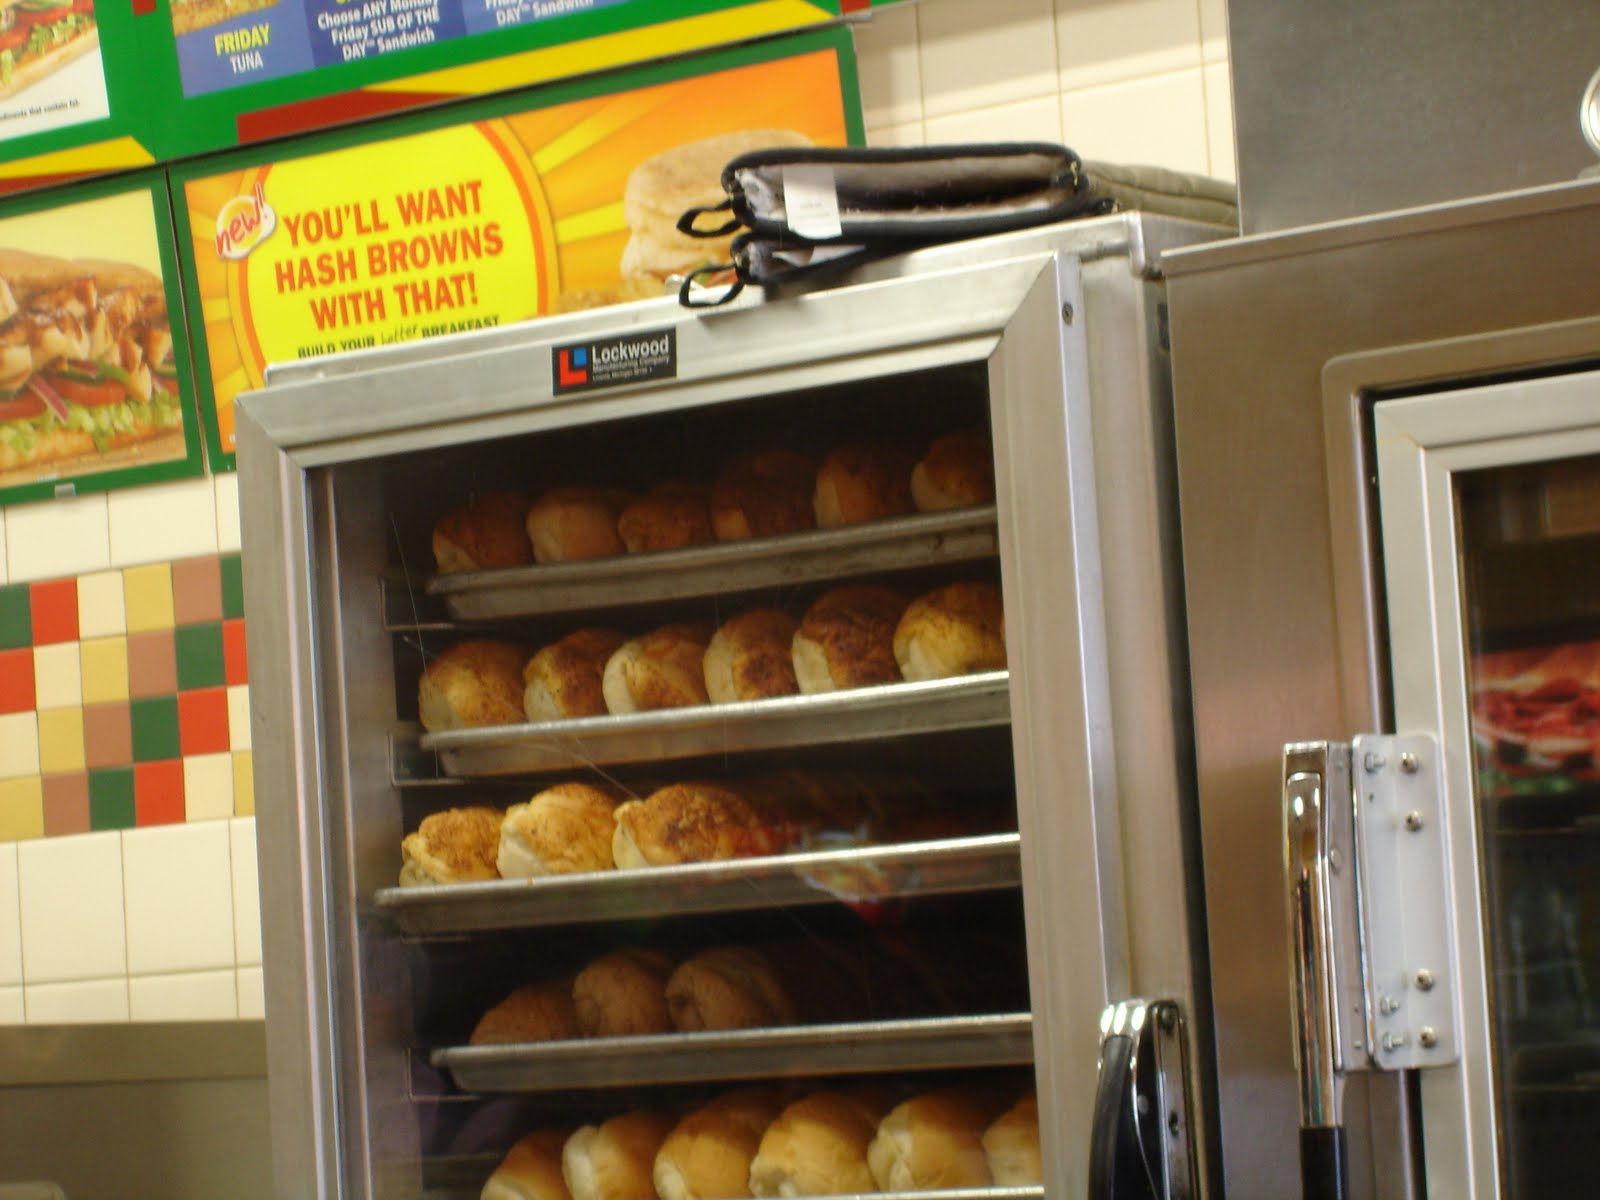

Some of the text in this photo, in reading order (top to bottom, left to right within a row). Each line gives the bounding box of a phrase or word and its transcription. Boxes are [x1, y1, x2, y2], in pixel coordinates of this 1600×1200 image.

[317, 9, 361, 30] Choose
[362, 0, 388, 20] ANY
[331, 6, 440, 46] Friday SUB OF THE
[214, 22, 270, 57] FRIDAY
[376, 25, 435, 53] Sandwich
[229, 50, 264, 74] TUNA
[214, 182, 268, 258] new!
[282, 180, 482, 248] YOU'LL WANT
[274, 222, 504, 294] HASH BROWNS
[309, 272, 479, 331] WITH THAT!
[298, 343, 337, 359] BUILD
[340, 335, 376, 352] YOUR
[421, 315, 500, 338] BREAKFAST
[592, 334, 670, 364] Lockwood
